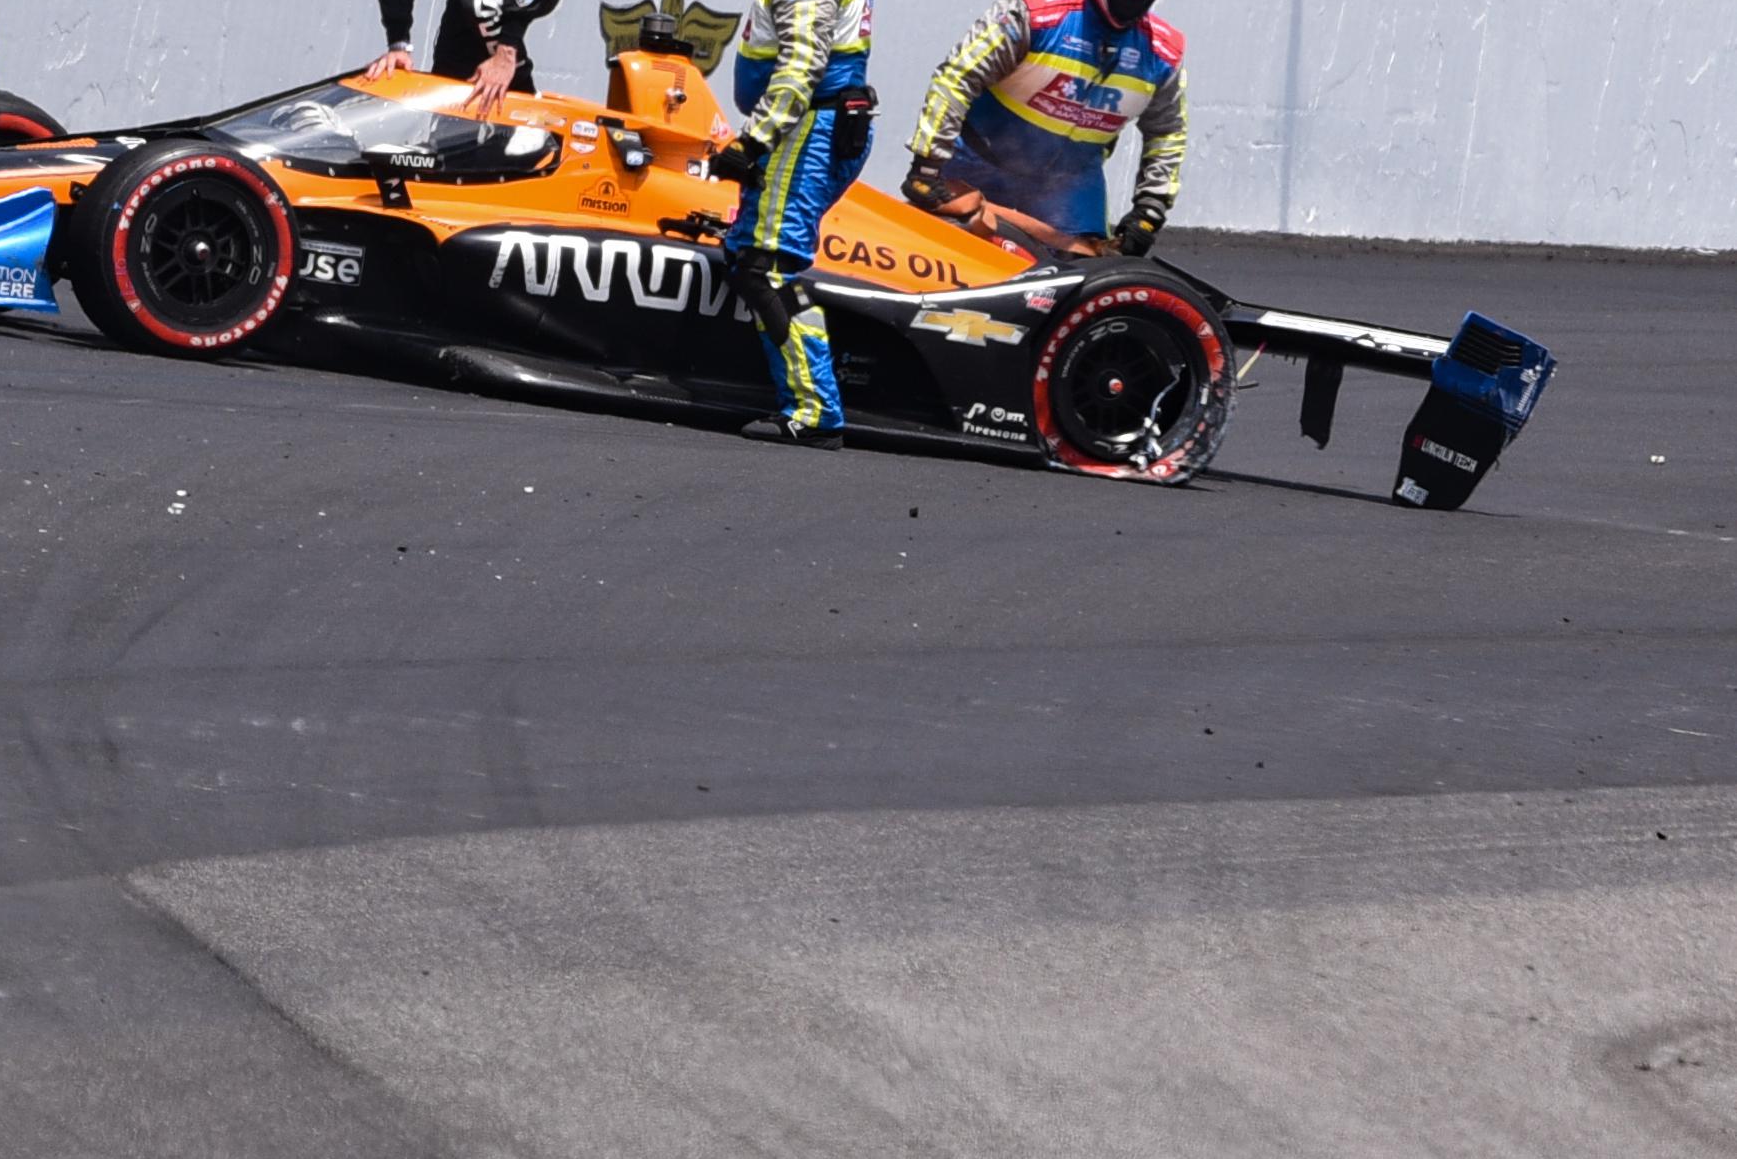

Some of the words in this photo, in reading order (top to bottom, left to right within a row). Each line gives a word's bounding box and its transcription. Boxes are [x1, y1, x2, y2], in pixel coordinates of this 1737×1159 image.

[1043, 72, 1123, 113] AMR
[118, 157, 217, 231] Firestone
[815, 234, 897, 271] CAS
[908, 254, 970, 289] OIL
[963, 421, 1028, 442] Firestone
[1453, 451, 1479, 473] TECH
